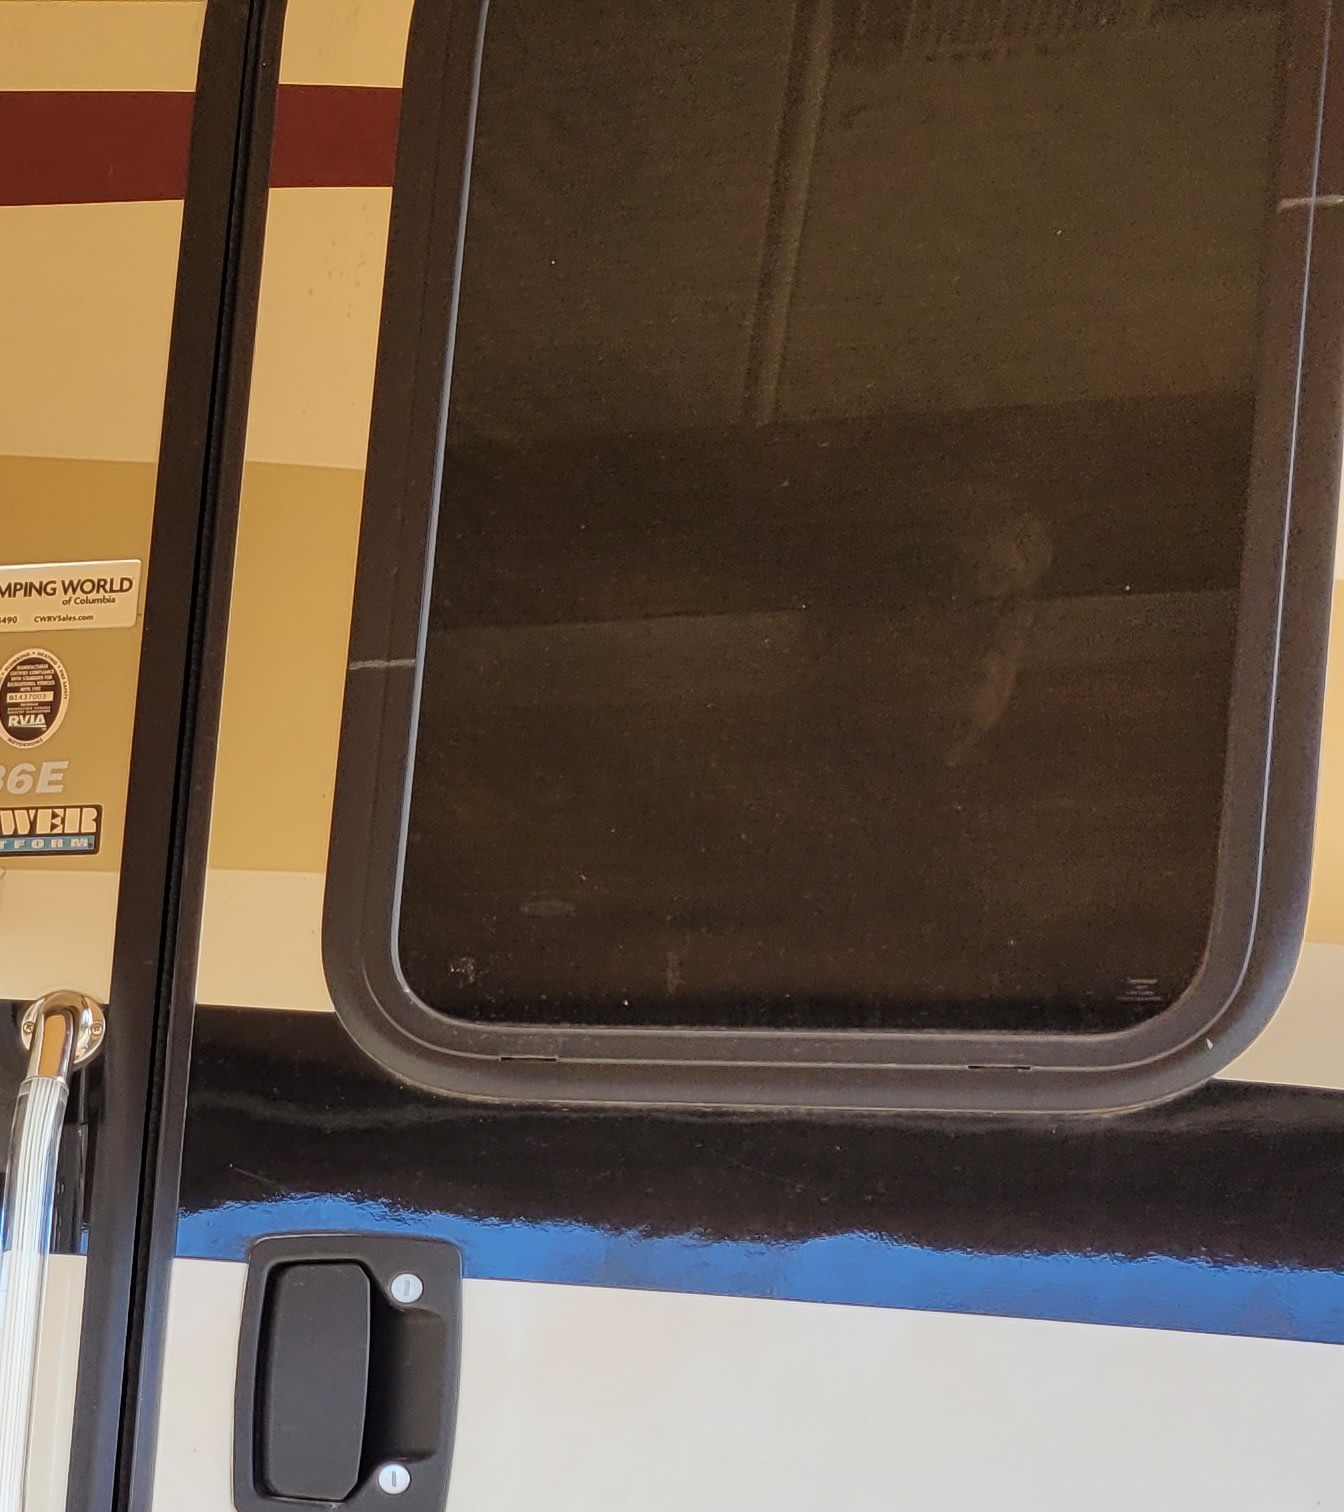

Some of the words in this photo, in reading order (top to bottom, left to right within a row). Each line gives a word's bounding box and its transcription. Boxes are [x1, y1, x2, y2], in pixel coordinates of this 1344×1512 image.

[61, 576, 134, 596] WORLD
[62, 597, 73, 606] of
[74, 594, 116, 606] Columbia
[8, 714, 47, 727] RVIA
